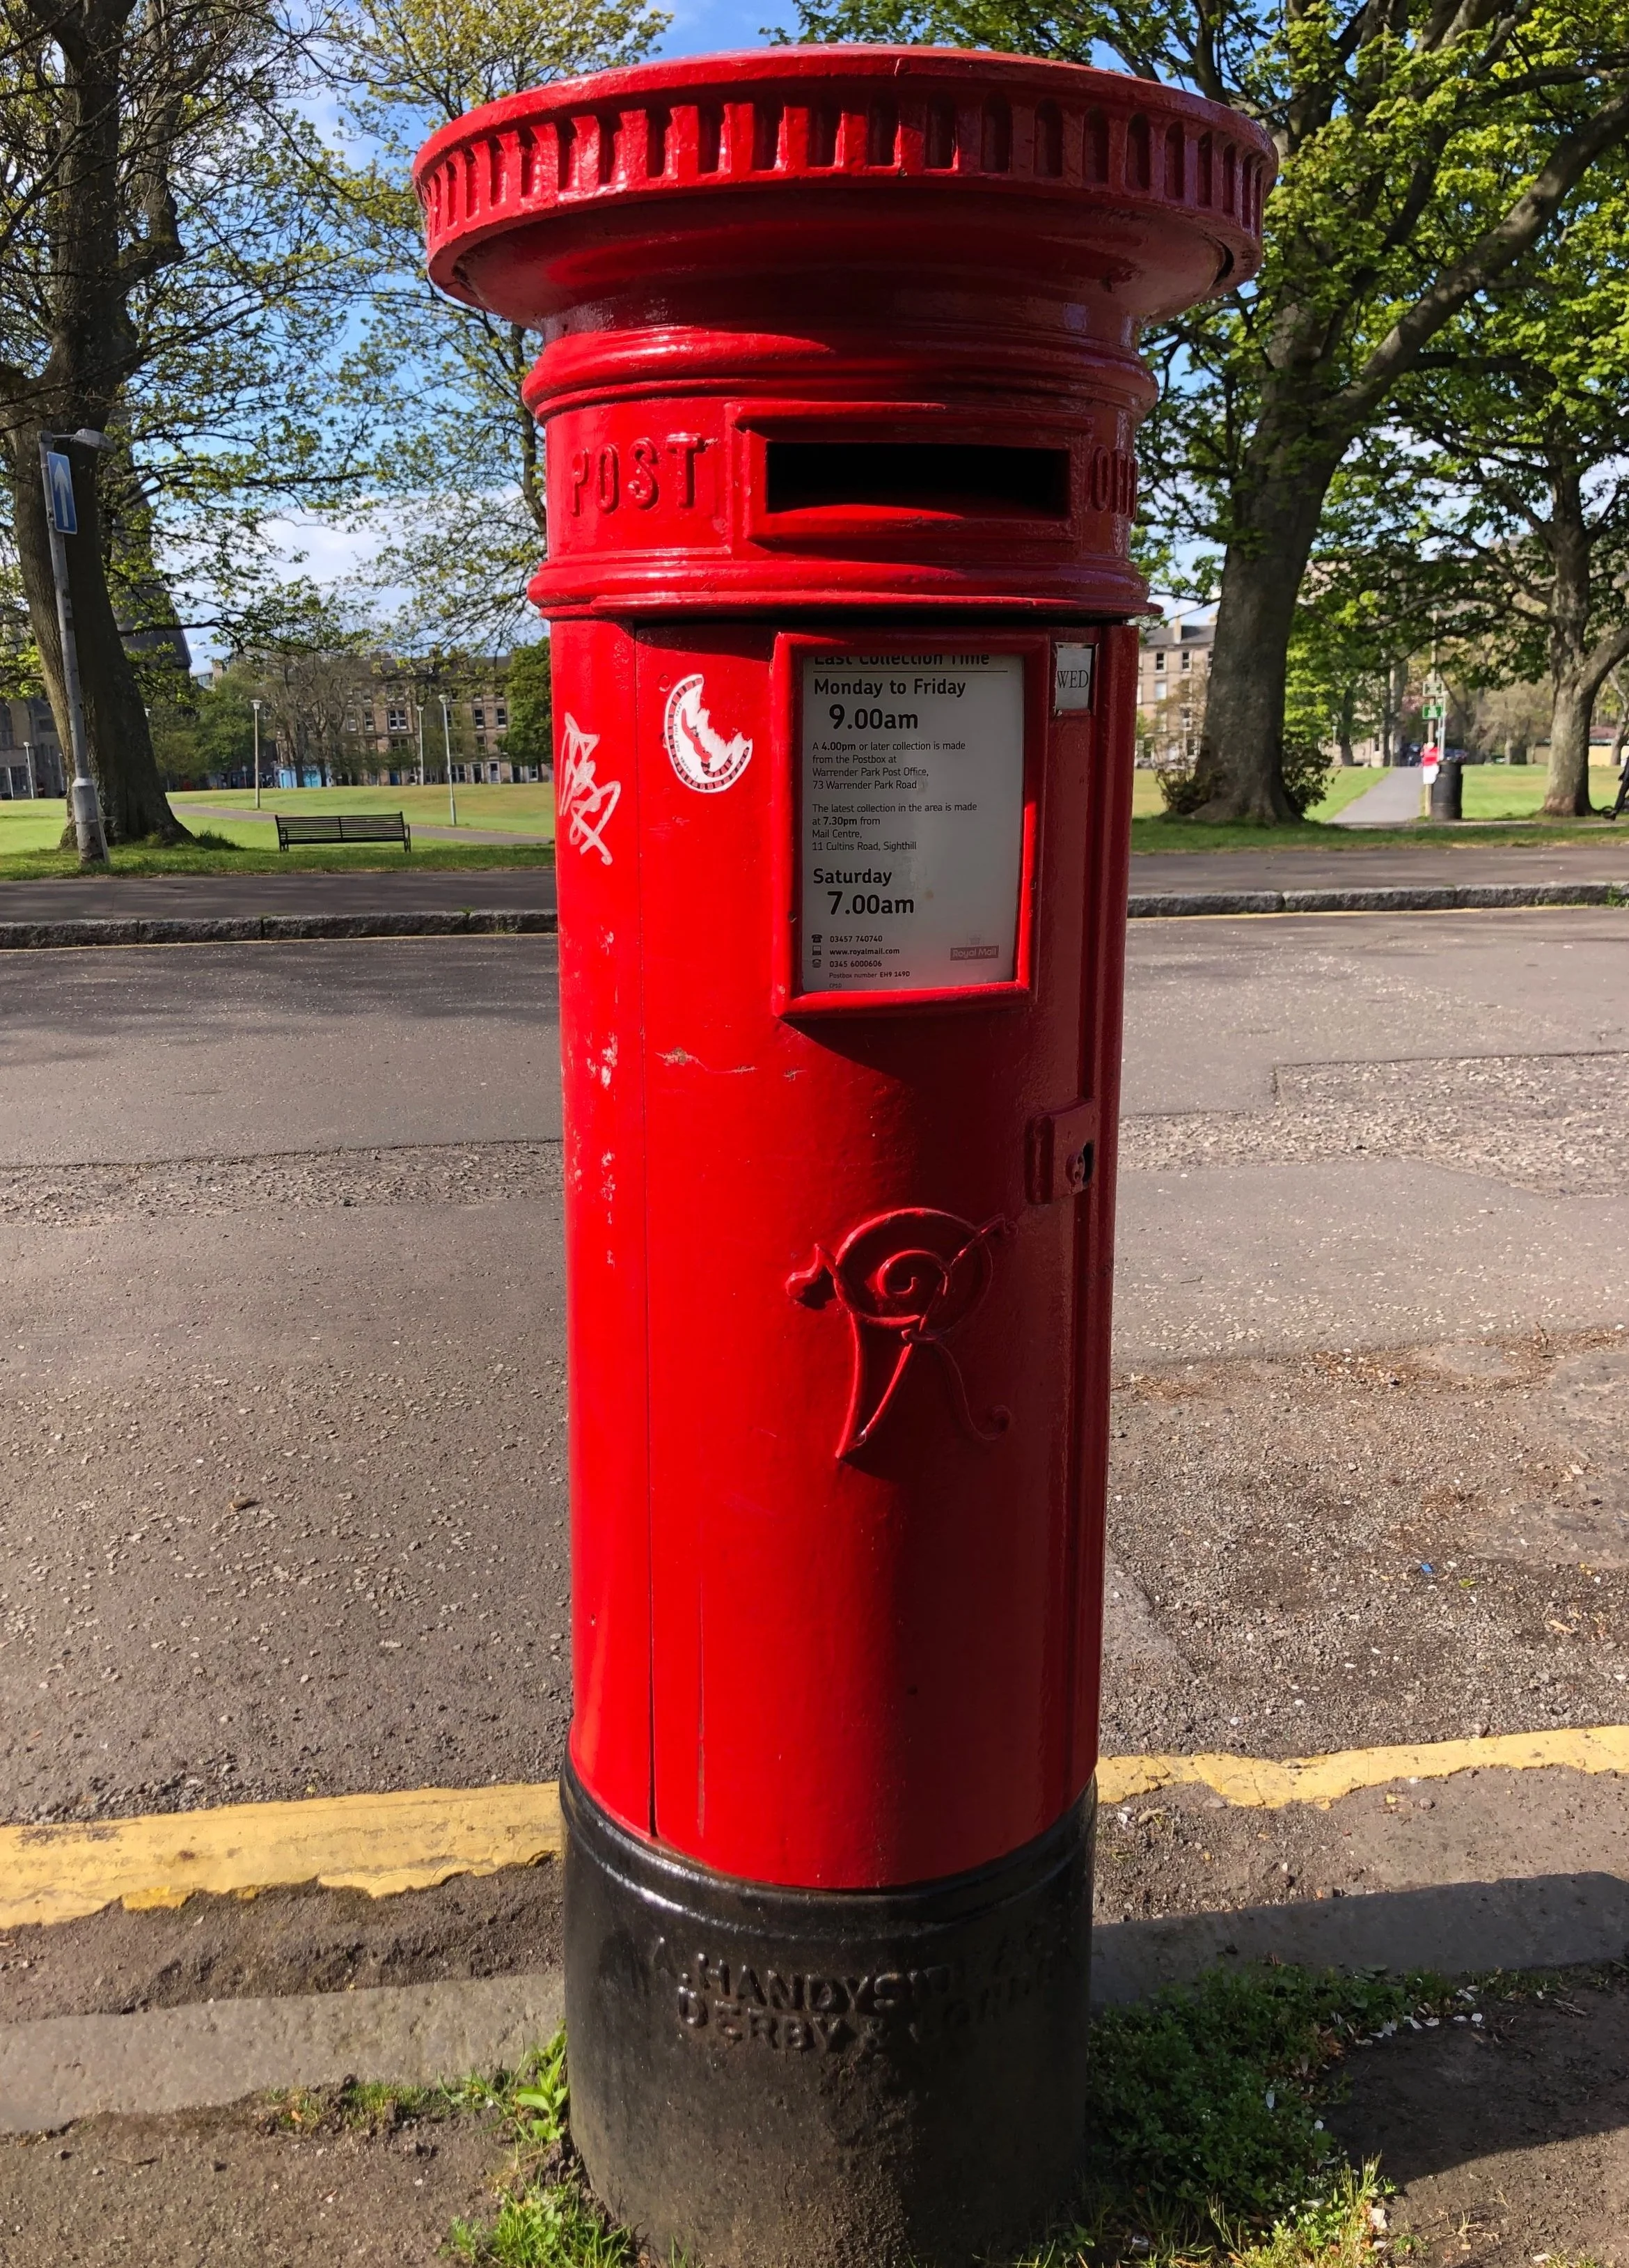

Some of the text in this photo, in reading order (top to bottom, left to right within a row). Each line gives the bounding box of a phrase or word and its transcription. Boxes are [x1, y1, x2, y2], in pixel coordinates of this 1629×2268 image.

[565, 431, 707, 517] POST
[1057, 670, 1089, 688] WED
[814, 678, 966, 698] Monday to Friday
[829, 704, 918, 730] 9.00am
[812, 742, 819, 751] A
[821, 741, 856, 753] 4.00pm
[870, 741, 890, 751] later
[892, 741, 931, 751] collection
[934, 741, 940, 750] is
[942, 741, 966, 750] made
[812, 754, 897, 764] from the Postbox at
[812, 767, 929, 777] Warrender Park Post Office,
[812, 779, 917, 790] 73 Warrender Park Road
[812, 804, 829, 813] The
[831, 804, 855, 813] latest
[856, 804, 896, 813] collection
[898, 803, 906, 812] in
[908, 803, 922, 812] the
[945, 802, 952, 812] is
[954, 801, 977, 811] made
[812, 816, 881, 827] at 7.30pm from
[812, 829, 863, 839] Mail Centre,
[812, 840, 917, 852] 11 Cultins Road, Sighthill
[813, 868, 892, 887] Saturday
[827, 891, 914, 915] 7.00am
[829, 947, 900, 956] www.royalmail.com
[952, 946, 997, 959] Royal Mail
[850, 960, 883, 968] 6000606
